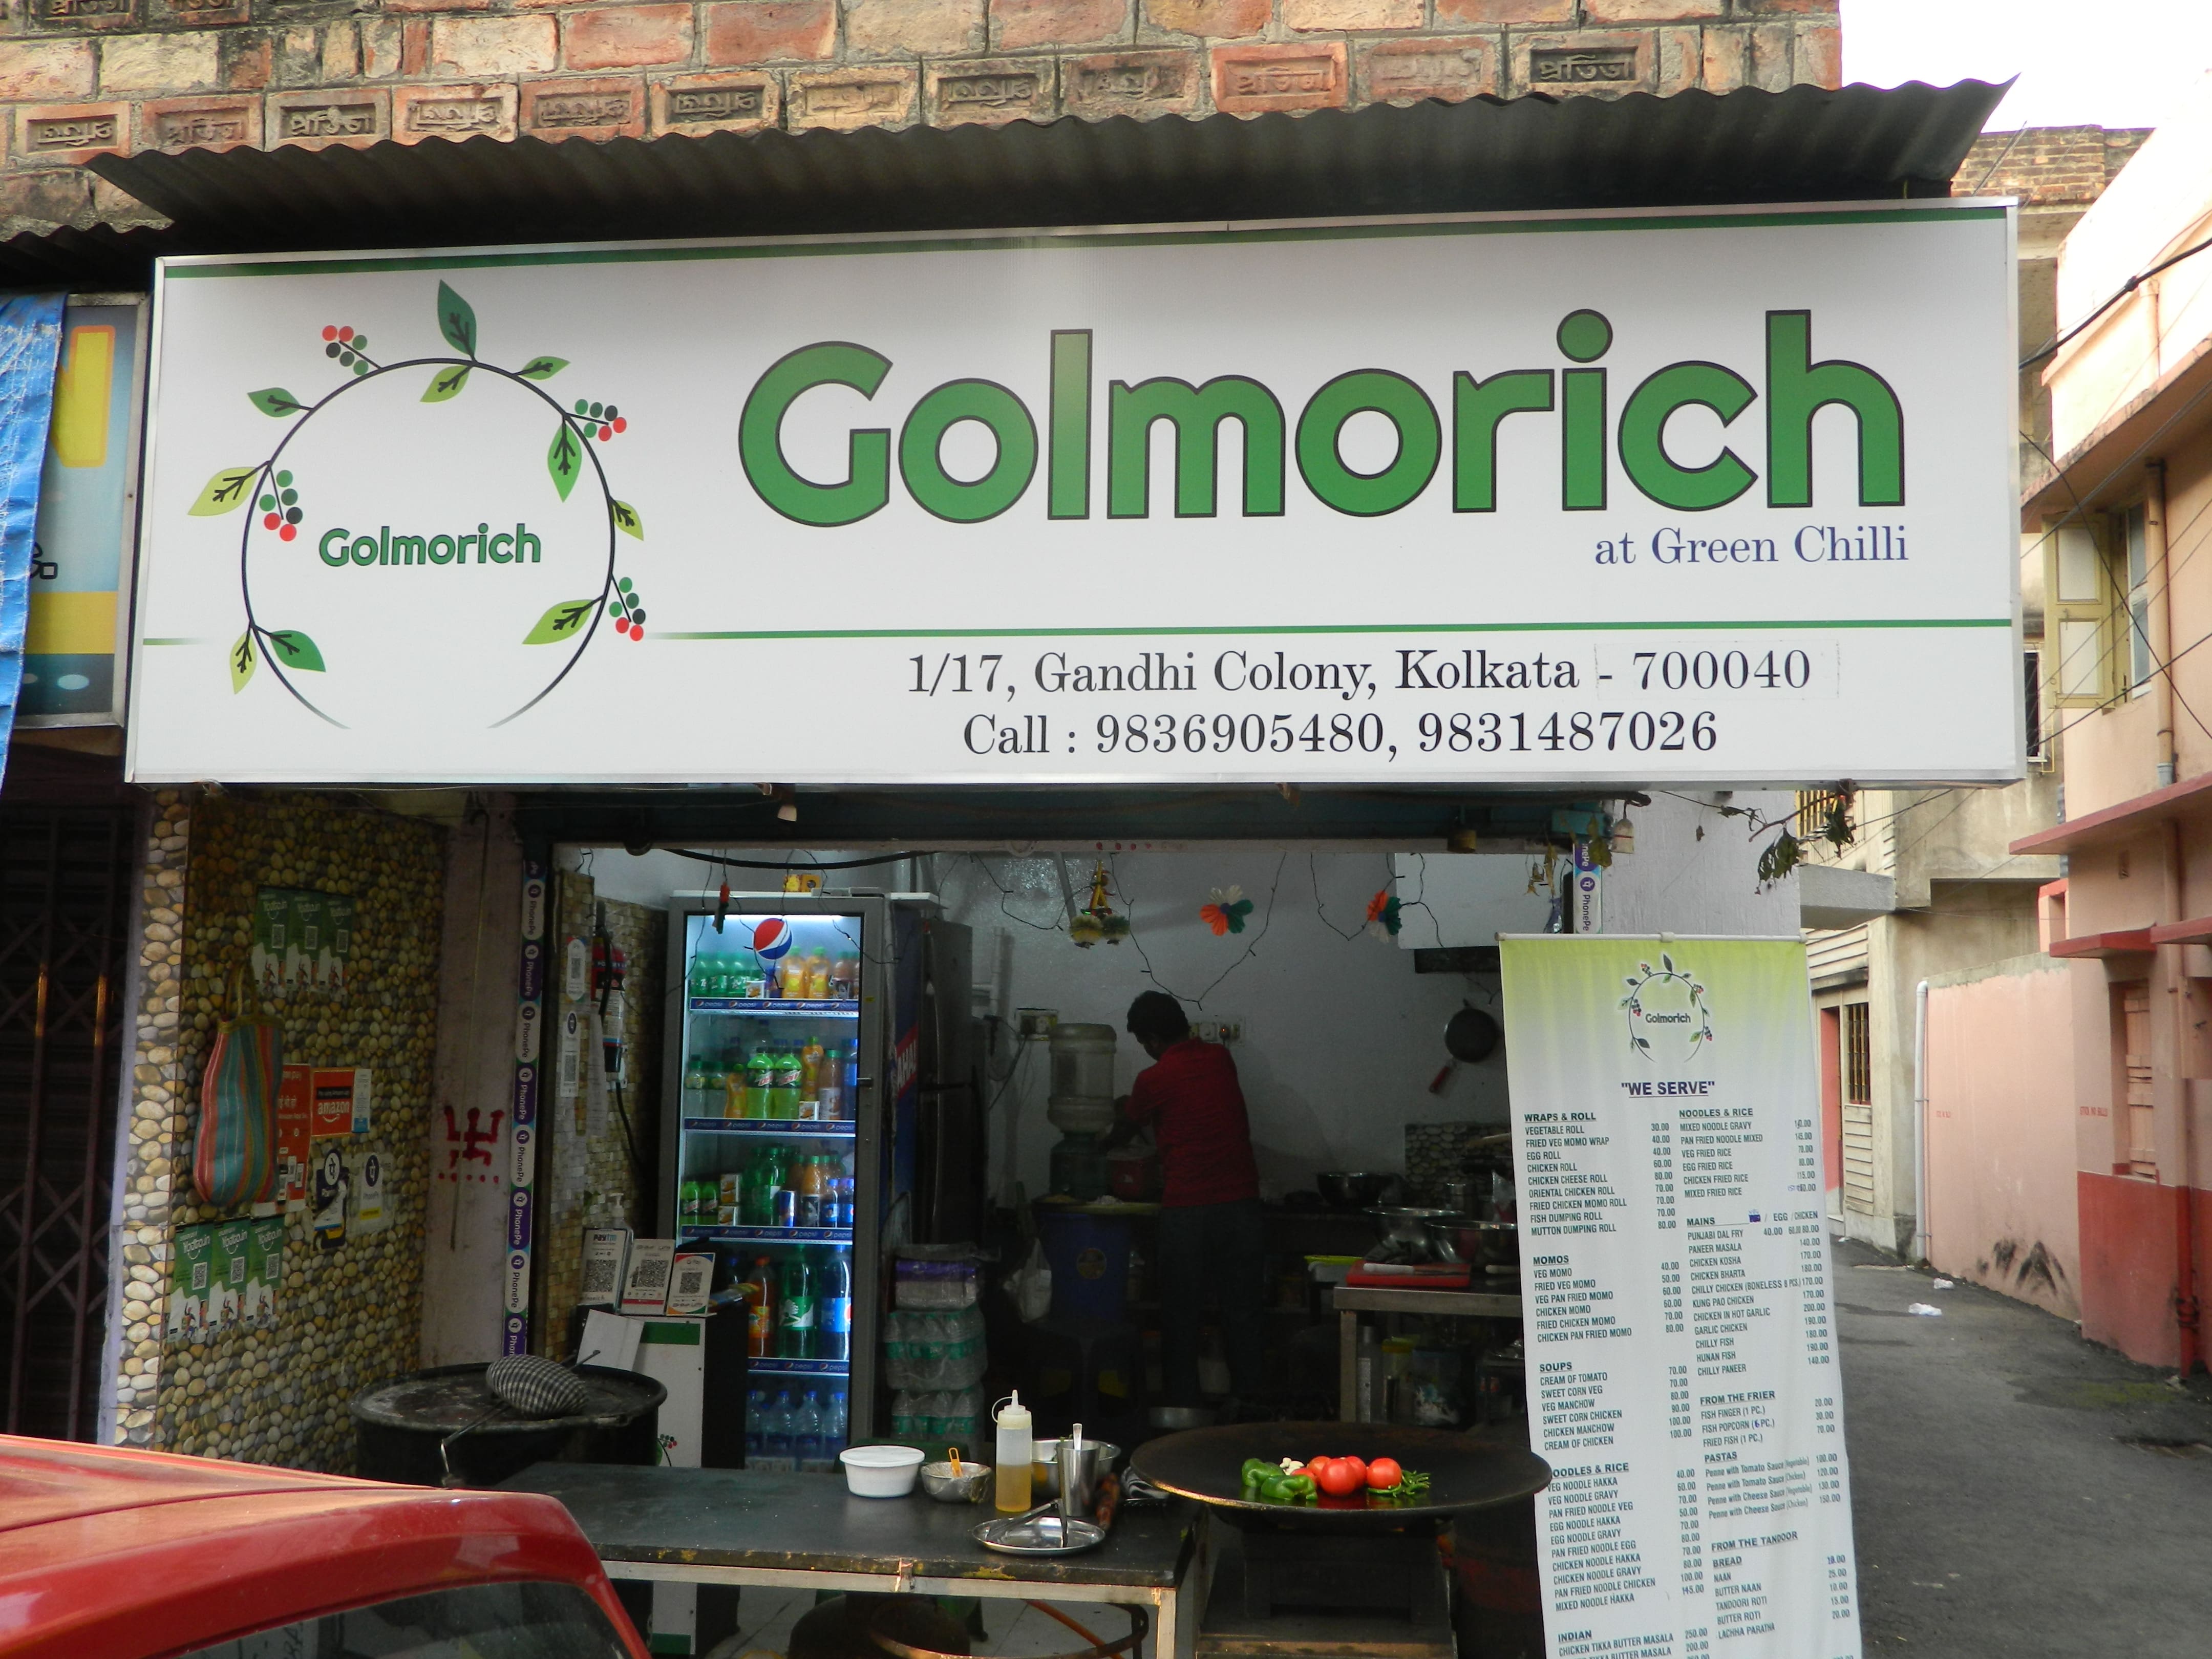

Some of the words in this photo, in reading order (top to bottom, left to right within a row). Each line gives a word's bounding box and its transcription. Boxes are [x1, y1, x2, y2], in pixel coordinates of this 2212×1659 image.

[1539, 55, 1631, 80] প্রতিভা
[738, 309, 1906, 527] Golmorich
[319, 522, 541, 567] Golmorich
[1595, 532, 1636, 564] at
[1652, 527, 1778, 564] Green
[1794, 525, 1908, 562] Chilli
[908, 653, 1016, 702] 1/17,
[1034, 651, 1198, 693] Gandhi
[1214, 650, 1377, 701] Colony,
[1395, 649, 1580, 690] Kolkata
[1632, 649, 1811, 690] 700040
[964, 714, 1050, 754] Call
[1096, 712, 1397, 762] 9836905480,
[1418, 711, 1717, 752] 9831487026
[1645, 1013, 1691, 1023] Golmorich
[522, 1023, 530, 1058] PhonePe
[1622, 1082, 1652, 1096] "WE
[1657, 1081, 1715, 1095] SERVE"
[317, 1101, 350, 1115] amazon
[1525, 1126, 1564, 1135] VEGETABLE
[1651, 1123, 1669, 1131] 30.00
[1680, 1123, 1700, 1131] MIXED
[1702, 1122, 1728, 1131] NOODLE
[1526, 1139, 1546, 1147] FRIED
[1549, 1138, 1562, 1146] VEG
[1564, 1138, 1587, 1146] MOMO
[1652, 1135, 1670, 1143] 40.00
[1543, 1151, 1561, 1159] ROLL
[1696, 1149, 1715, 1157] FRIED
[517, 1146, 525, 1182] PhonePe
[1527, 1164, 1558, 1173] CHICKEN
[1528, 1177, 1559, 1185] CHICKEN
[1561, 1175, 1587, 1184] CHEESE
[1529, 1188, 1563, 1198] ORIENTAL
[1565, 1187, 1596, 1196] CHICKEN
[1598, 1186, 1614, 1195] ROLL
[1655, 1184, 1673, 1192] 70.00
[1529, 1202, 1550, 1210] FRIED
[1552, 1200, 1582, 1209] CHICKEN
[1584, 1199, 1607, 1208] MOMO
[1609, 1198, 1627, 1206] ROLL
[1656, 1196, 1674, 1204] 70.00
[1530, 1215, 1546, 1223] FISH
[1549, 1213, 1581, 1222] DUMPING
[1657, 1208, 1675, 1217] 70.00
[1794, 1211, 1818, 1220] CHICKEN
[514, 1209, 522, 1245] PhonePe
[1531, 1226, 1561, 1236] MUTTON
[1563, 1225, 1597, 1234] DUMPING
[1599, 1224, 1616, 1232] ROLL
[1658, 1221, 1676, 1229] 80.00
[1688, 1231, 1715, 1240] PUNJABI
[1763, 1227, 1782, 1236] 40.00
[1689, 1244, 1714, 1253] PANEER
[1716, 1243, 1741, 1251] MASALA
[1533, 1256, 1569, 1265] MOMOS
[1661, 1262, 1679, 1270] 40.00
[1534, 1270, 1547, 1278] VEG
[1549, 1268, 1572, 1277] MOMO
[512, 1272, 520, 1308] PhonePe
[1663, 1287, 1681, 1295] 60.00
[1535, 1295, 1549, 1304] VEG
[1551, 1294, 1565, 1303] PAN
[1567, 1293, 1587, 1302] FRIED
[1589, 1291, 1613, 1300] MOMO
[1803, 1303, 1825, 1312] 200.00
[1694, 1325, 1718, 1335] GARLIC
[1720, 1323, 1748, 1332] CHICKEN
[1540, 1362, 1572, 1372] SOUPS
[1669, 1366, 1687, 1374] 70.00
[1540, 1376, 1565, 1386] CREAM
[1567, 1375, 1576, 1384] OF
[1579, 1372, 1607, 1382] TOMATO
[1671, 1391, 1689, 1399] 80.00
[1700, 1395, 1725, 1405] FROM
[1748, 1391, 1775, 1399] FRIER
[1542, 1402, 1556, 1412] VEG
[1558, 1399, 1595, 1410] MANCHOW
[1701, 1411, 1715, 1419] FISH
[1718, 1408, 1740, 1418] FINGER
[1705, 1452, 1737, 1462] PASTAS
[1552, 1465, 1591, 1477] OODLES
[1595, 1465, 1601, 1473] &
[1605, 1463, 1628, 1472] RICE
[1705, 1469, 1725, 1477] Penne
[1726, 1465, 1739, 1474] with
[1741, 1463, 1764, 1473] Tomato
[1547, 1483, 1561, 1492] VEG
[1563, 1480, 1591, 1490] NOODLE
[1593, 1477, 1618, 1487] HAKKA
[1711, 1541, 1735, 1551] FROM
[1738, 1539, 1757, 1547] THE
[1760, 1531, 1798, 1545] TANDOOR
[1713, 1556, 1741, 1567] BREAD
[1715, 1585, 1739, 1597] BUTTER
[1741, 1583, 1761, 1592] NAAN
[1556, 1601, 1578, 1611] MIXED
[1580, 1597, 1608, 1608] NOODLE
[1610, 1593, 1634, 1604] HAKKA
[1558, 1630, 1592, 1642] INDIAN
